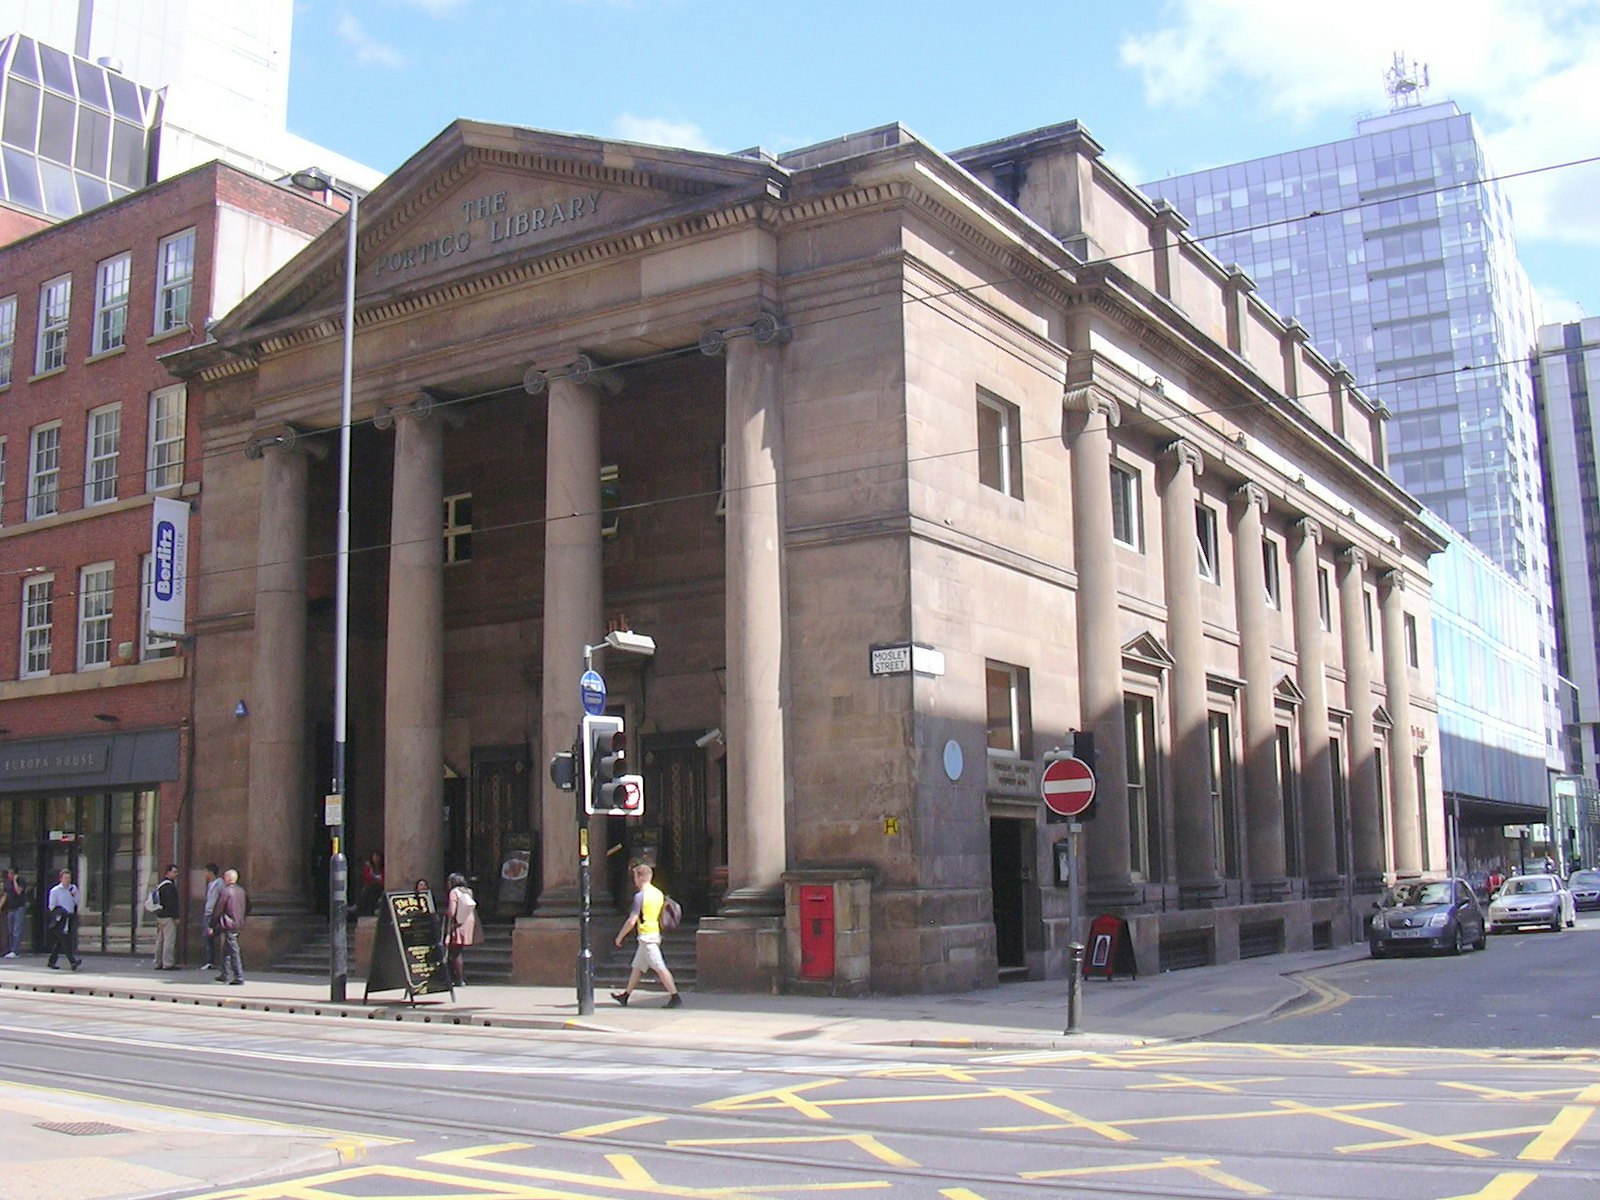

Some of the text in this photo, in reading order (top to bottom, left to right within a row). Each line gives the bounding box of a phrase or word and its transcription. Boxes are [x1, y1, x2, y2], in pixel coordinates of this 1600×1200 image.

[461, 191, 507, 223] THE
[373, 191, 603, 277] PORTICO LIBRARY
[156, 529, 173, 595] Berlitz
[176, 532, 185, 596] MANCHESTER
[874, 649, 907, 661] MOSLEY
[875, 661, 904, 672] STREET
[5, 752, 94, 771] EUROPA HOUSE
[884, 818, 898, 834] H
